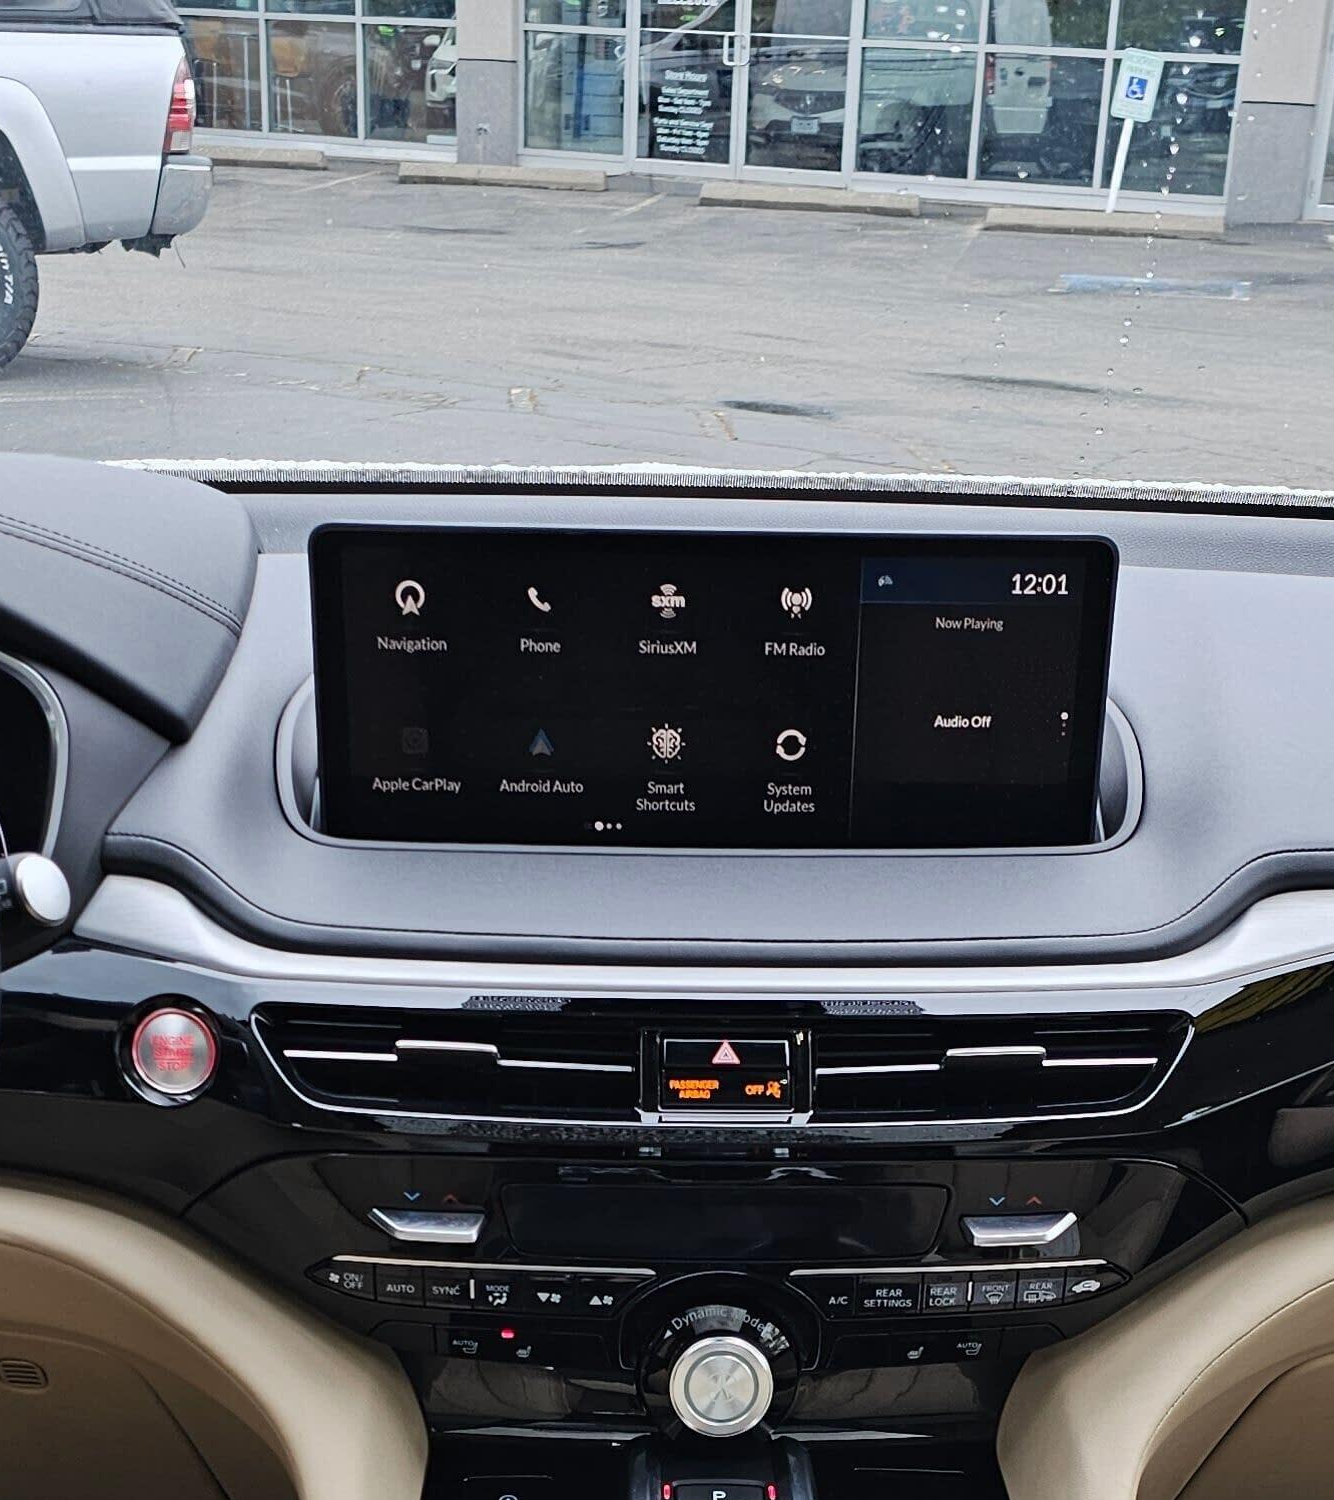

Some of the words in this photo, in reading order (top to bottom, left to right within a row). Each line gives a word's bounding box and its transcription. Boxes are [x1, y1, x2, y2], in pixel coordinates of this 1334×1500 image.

[1012, 574, 1068, 594] 12:01
[936, 617, 962, 628] Now
[964, 618, 1003, 631] Playing
[377, 637, 447, 653] Navigation
[521, 639, 560, 652] Phone
[639, 640, 696, 654] SiriusXM
[765, 642, 786, 655] FM
[790, 643, 825, 656] Radio
[934, 716, 969, 727] Audio
[971, 716, 991, 727] Off
[373, 778, 408, 792] Apple
[412, 778, 461, 793] CarPlay
[500, 780, 550, 792] Android
[553, 781, 583, 792] Auto
[648, 782, 684, 794] Smart
[766, 782, 812, 800] System
[637, 799, 695, 811] Shortcuts
[763, 799, 815, 815] Updates
[669, 1079, 719, 1090] PASSENGER
[745, 1084, 765, 1095] OFF
[679, 1089, 711, 1099] AIRBAG
[343, 1271, 365, 1284] ON/
[343, 1281, 365, 1290] OFF
[387, 1284, 414, 1293] AUTO
[430, 1283, 461, 1298] SYNC
[485, 1283, 511, 1293] MODE
[929, 1286, 958, 1297] REAR
[981, 1283, 1010, 1293] FRONT
[1028, 1280, 1053, 1291] REAR
[876, 1289, 902, 1297] REAR
[829, 1296, 847, 1304] A/C
[929, 1297, 956, 1307] LOCK
[671, 1307, 728, 1330] Dynamic
